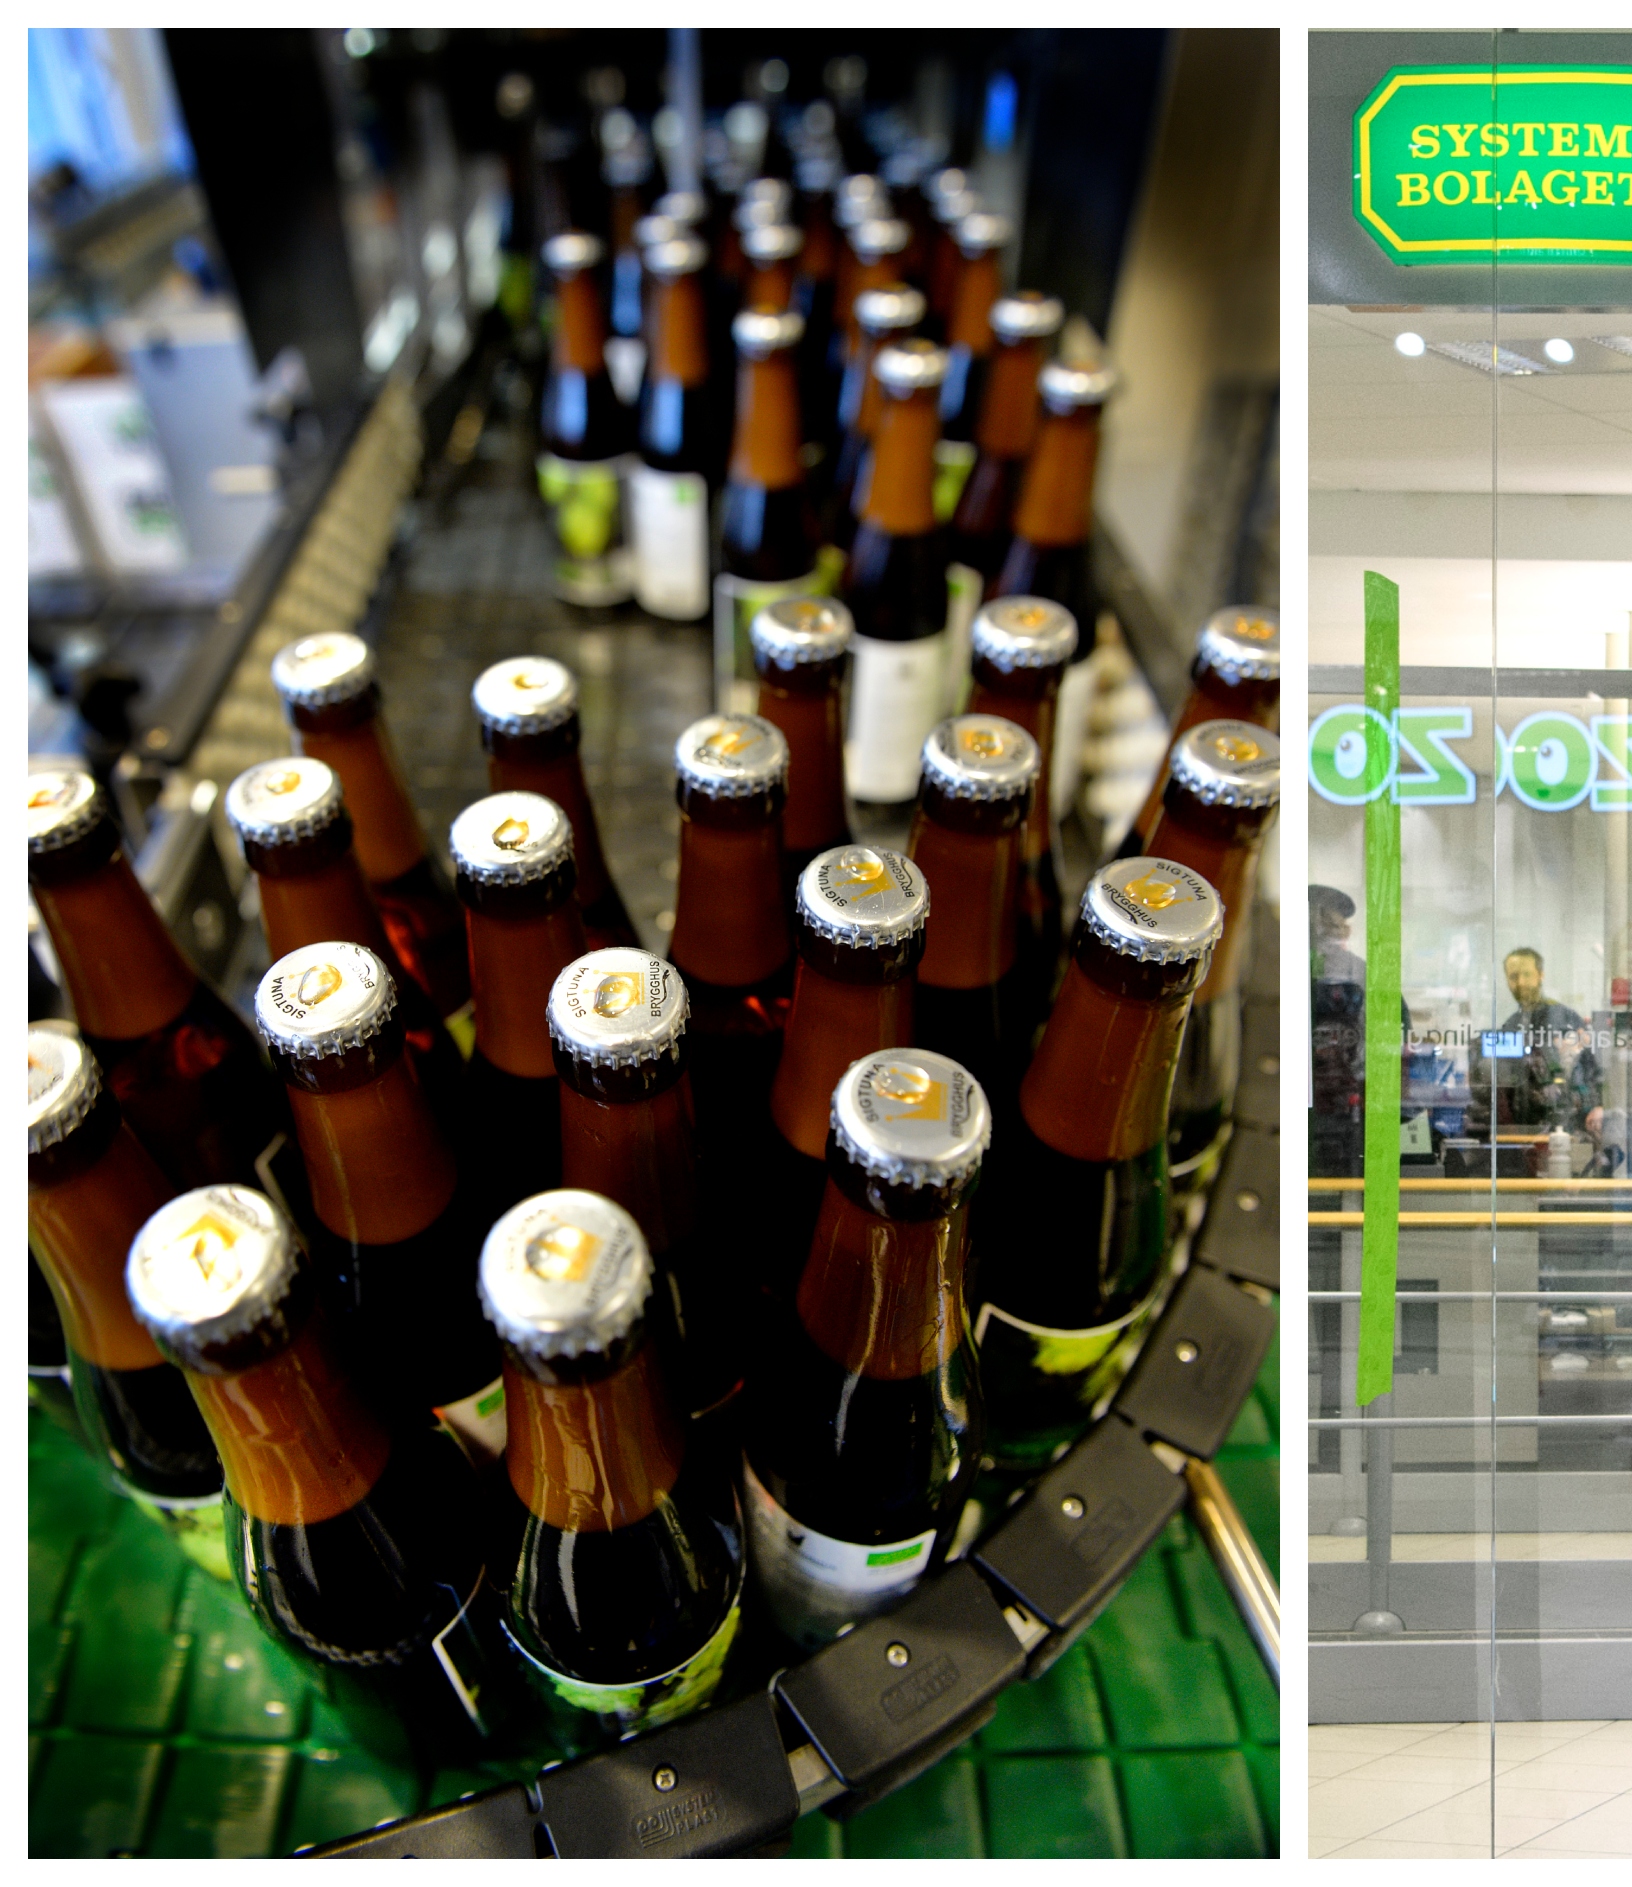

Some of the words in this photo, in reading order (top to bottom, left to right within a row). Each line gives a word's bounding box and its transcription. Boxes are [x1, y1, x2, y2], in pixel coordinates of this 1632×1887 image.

[1410, 122, 1632, 159] SYSTEM
[818, 864, 848, 908] SIGTUNA
[883, 852, 916, 898] BRYGGHUS
[1156, 862, 1208, 901] SIGTUNA
[1101, 883, 1158, 928] BRYGGHUS
[271, 976, 307, 1020] SIGTUNA
[566, 966, 590, 1019] SIGTUNA
[649, 960, 662, 1018] BRYGGHUS
[857, 1063, 885, 1123] SIGTUNA
